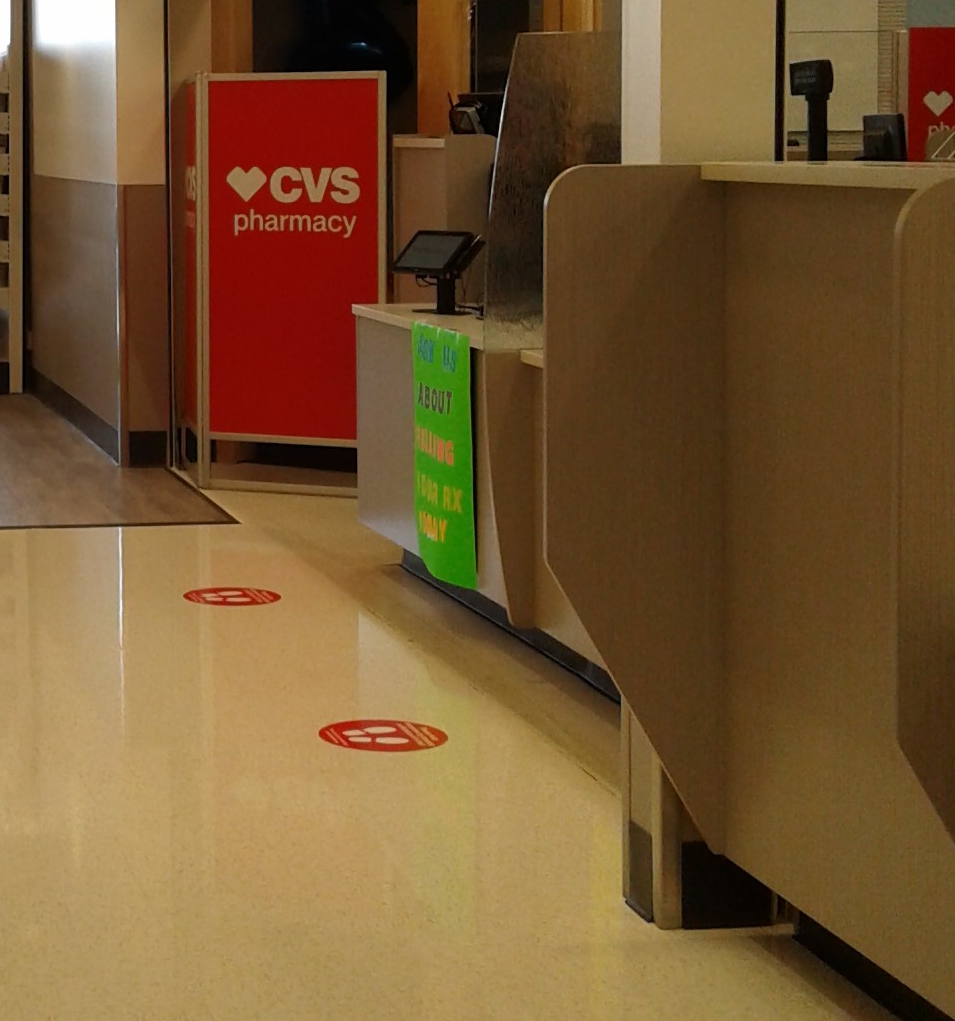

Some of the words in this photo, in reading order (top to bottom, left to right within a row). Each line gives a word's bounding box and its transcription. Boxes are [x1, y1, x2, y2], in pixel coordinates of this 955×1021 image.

[269, 166, 361, 204] CVS
[234, 208, 357, 239] pharmacy
[418, 381, 453, 415] ABOUT
